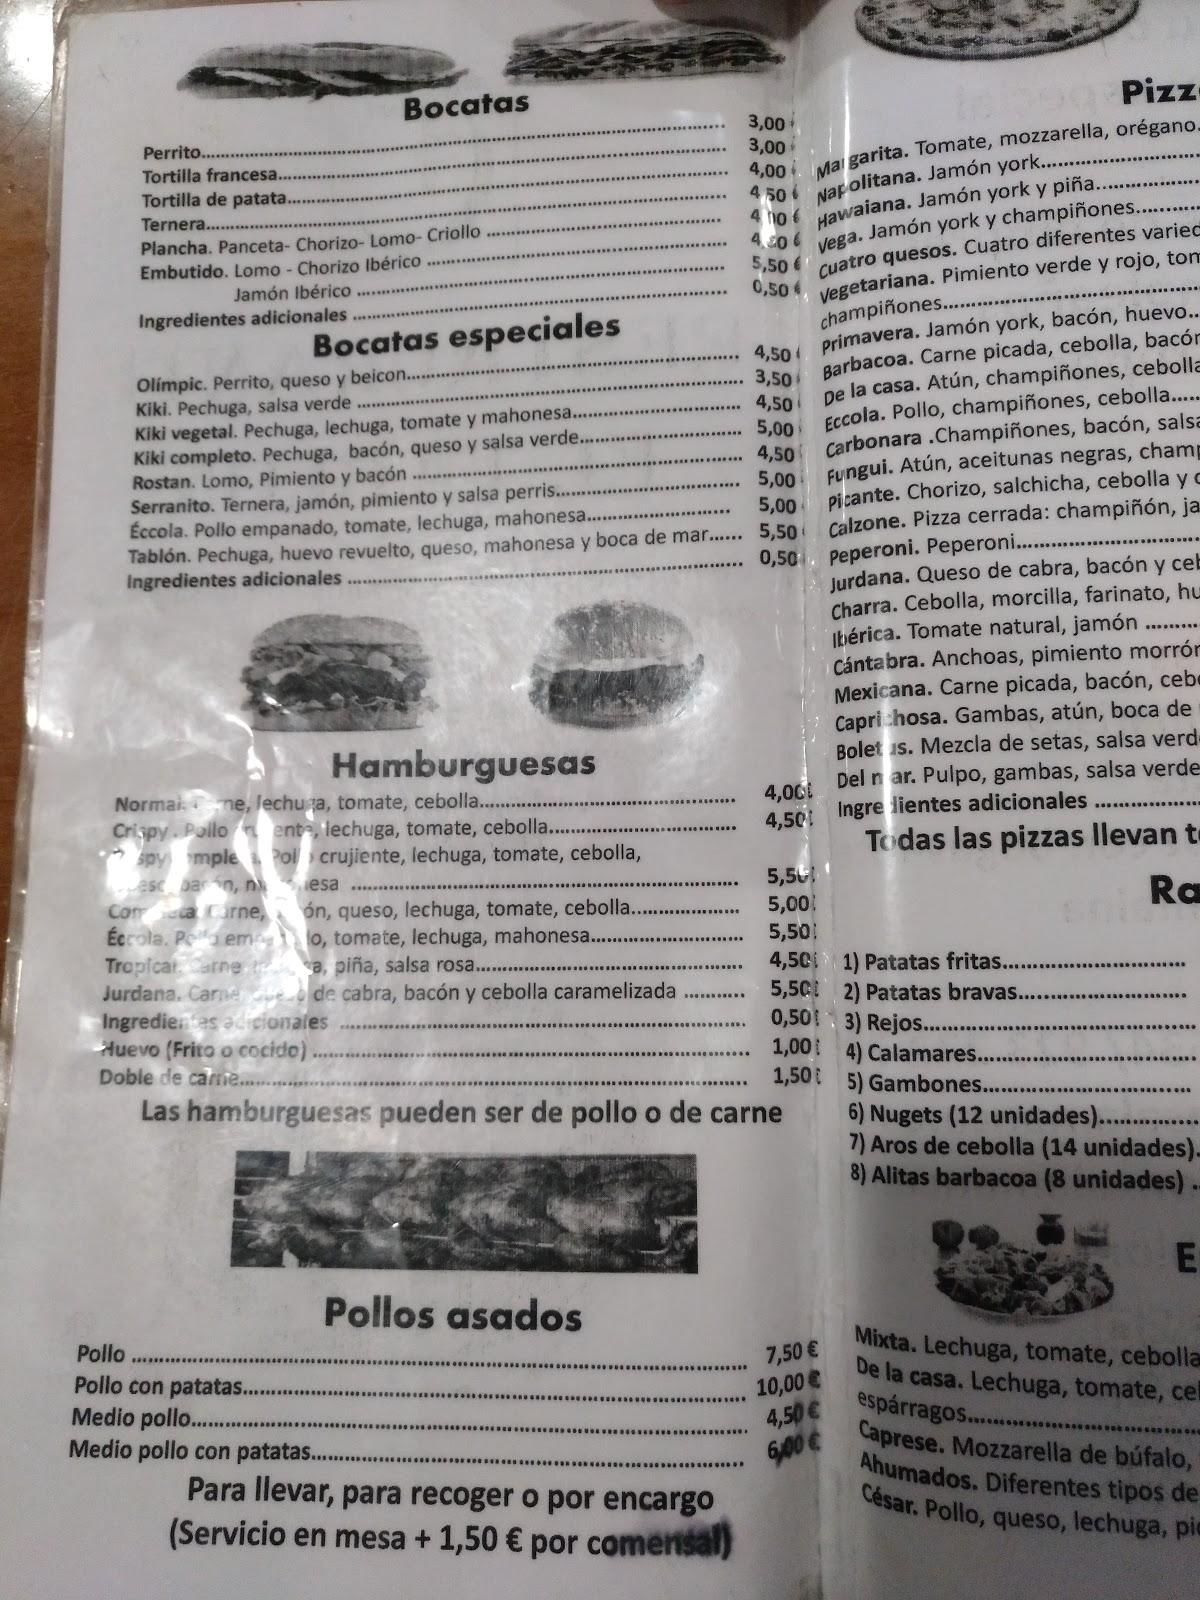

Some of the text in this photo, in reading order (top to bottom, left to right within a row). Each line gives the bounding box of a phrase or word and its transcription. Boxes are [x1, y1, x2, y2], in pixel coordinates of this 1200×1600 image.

[404, 93, 529, 121] Bocatas
[1121, 77, 1200, 105] Pizz
[749, 114, 785, 132] 3,00
[915, 124, 1109, 156] Tomate, mozzarella,
[142, 162, 786, 207] Tortilla de 4,00
[141, 225, 480, 256] Plancha. Panceta- Chorizo- Lomo- Criollo
[869, 213, 979, 240] Jamón york
[140, 256, 421, 280] Embutido. Lomo Chorizo Ibérico
[819, 226, 1135, 280] Cuatro quesos. Cuatro diferentes
[234, 257, 788, 303] Jamón Ibérico 5,50
[942, 257, 1091, 284] Pimiento verde
[139, 280, 788, 331] Ingredientes adicionales 0,50
[313, 312, 621, 358] Bocatas especiales
[926, 308, 1118, 338] Jamón bacón,
[136, 345, 791, 395] Olímpic. Perrito, queso 4,50
[823, 333, 1138, 381] Barbacoa. Carne picada, cebolla,
[136, 370, 792, 418] Kiki. Pechuga, salsa verde 3,50
[825, 363, 1125, 408] De la casa. Atún, champiñones,
[244, 414, 461, 440] Pechuga, lechuga, tomate
[825, 391, 1090, 433] Eccola. Pollo, champiñones,
[202, 446, 795, 489] Lomo, Pimiento bacón 4,50
[913, 495, 1176, 528] Pizza cerrada: champiñón,
[831, 552, 1148, 594] Jurdana. Queso de cabra, bacón
[831, 581, 1170, 621] Charra. Cebolla, morcilla, farinato,
[921, 730, 1145, 756] Mezcla setas, salsa
[332, 749, 596, 784] Hamburguesas
[954, 822, 1177, 854] las pizzas llevan
[320, 844, 641, 867] crujiente, lechuga, tomate, cebolla,
[865, 953, 940, 971] Patatas
[482, 982, 677, 999] cebolla caramelizada
[866, 983, 941, 1001] Patatas
[772, 1009, 811, 1028] 0,50
[774, 1067, 812, 1086] 1,50
[141, 1100, 782, 1128] Las hamburguesas pueden ser de pollo de carne
[870, 1105, 982, 1128] Nugets (12
[871, 1135, 1077, 1160] Aros de cebolla (14
[851, 1164, 1183, 1193] 8) Alitas barbacoa (8 unidades)
[325, 1295, 582, 1332] Pollos asados
[77, 1341, 818, 1364] Pollo 7,50 €
[855, 1325, 1113, 1367] Mixta. Lechuga, tomate,
[74, 1372, 804, 1397] Pollo con 10,00
[856, 1356, 1163, 1402] De la casa. Lechuga, tomate,
[69, 1440, 188, 1462] Medio pollo
[859, 1420, 1192, 1471] Caprese. Mozzarella búfalo,
[860, 1452, 1164, 1505] Ahumados. Diferentes tipos
[188, 1476, 714, 1517] Para llevar, para recoger por encargo
[862, 1483, 1167, 1540] César. Pollo, queso, lechuga,
[170, 1518, 578, 1559] (Servicio en mesa 1,50 € por
